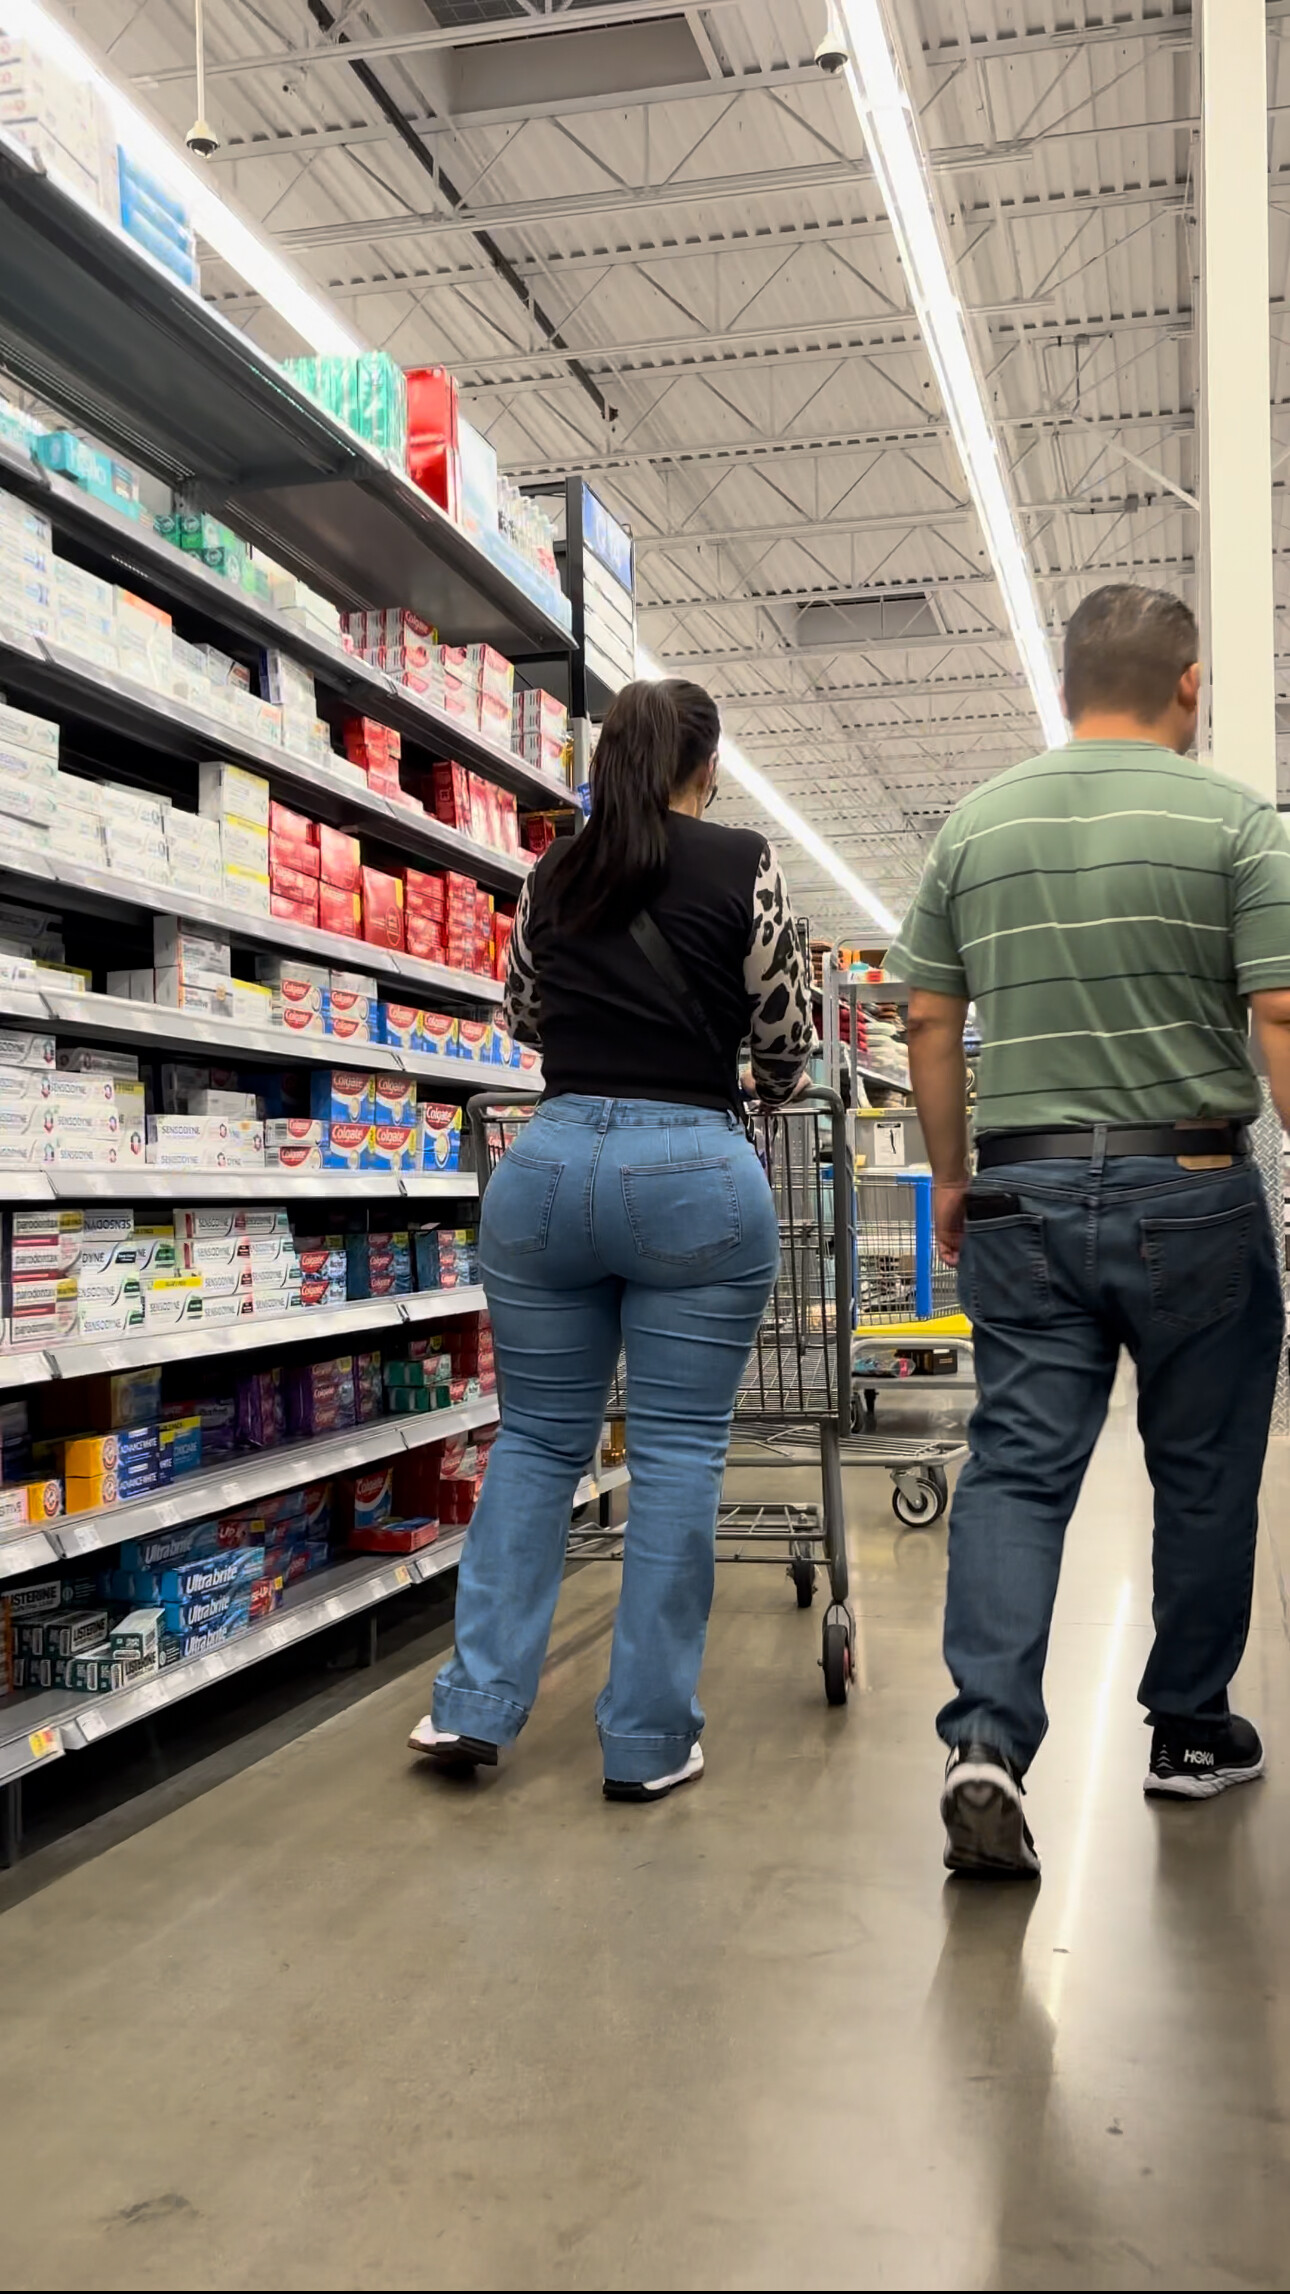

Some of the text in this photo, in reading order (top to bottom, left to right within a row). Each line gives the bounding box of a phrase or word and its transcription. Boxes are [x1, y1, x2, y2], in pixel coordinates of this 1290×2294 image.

[333, 1073, 364, 1090] Colgate
[427, 1106, 453, 1122] Colgate
[332, 1124, 363, 1141] Colgate
[376, 1128, 405, 1143] Colgate
[186, 1565, 238, 1594] Ultrabrite
[188, 1596, 230, 1625] Ultrabrite
[183, 1749, 215, 1766] HOKA
